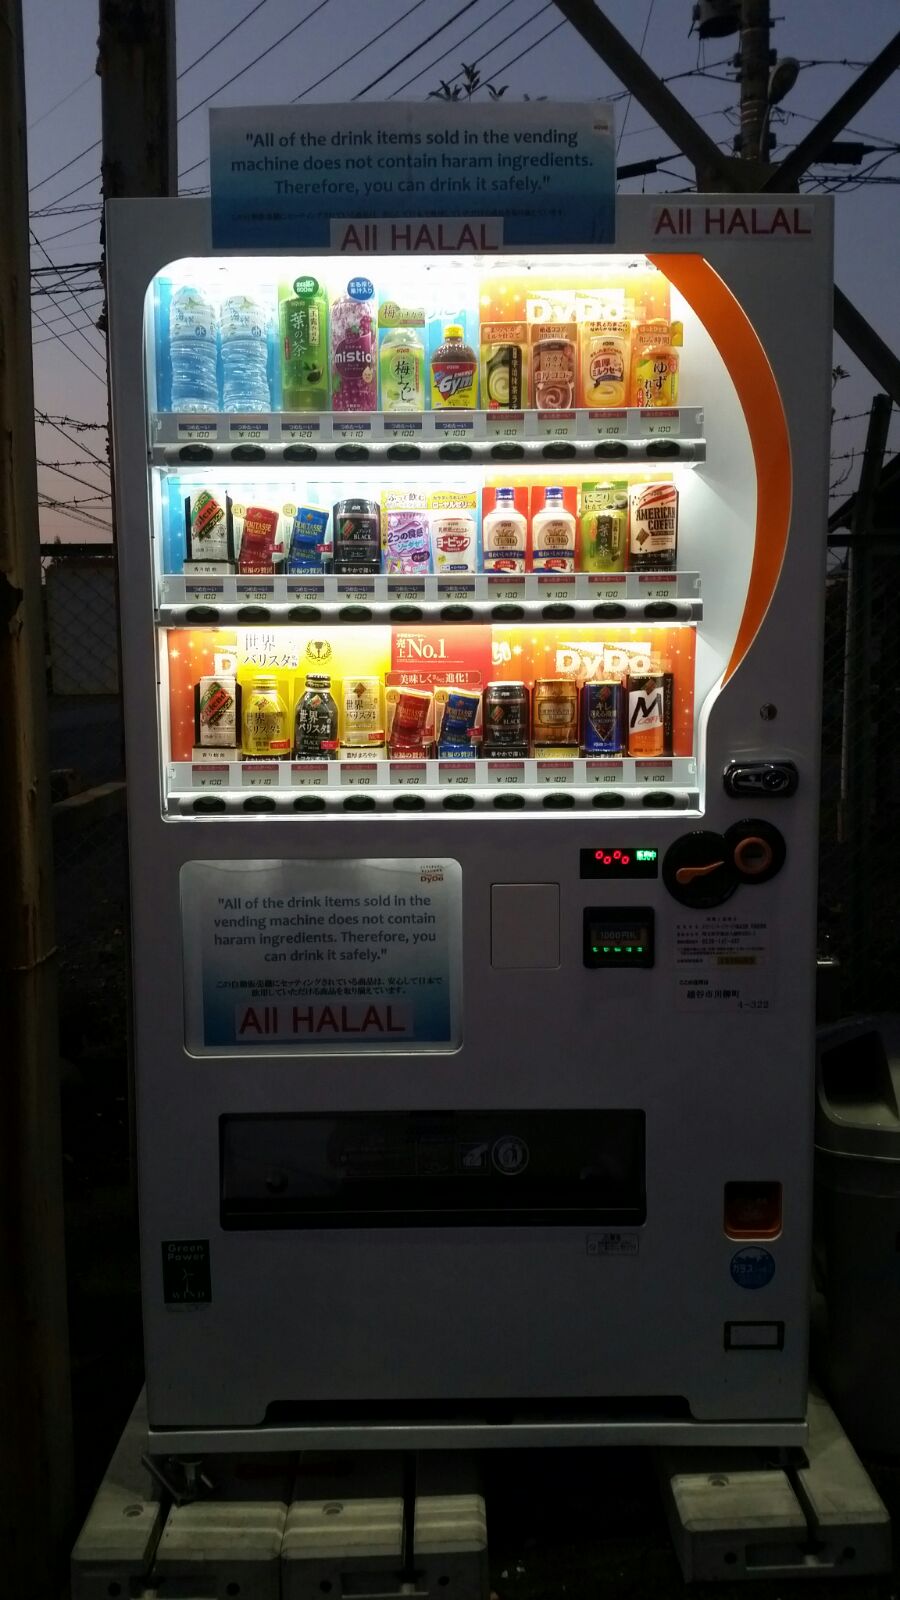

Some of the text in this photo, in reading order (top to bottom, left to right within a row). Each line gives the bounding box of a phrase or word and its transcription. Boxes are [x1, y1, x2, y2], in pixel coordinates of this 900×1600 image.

[279, 132, 296, 147] of
[300, 132, 326, 146] the
[331, 131, 373, 146] drink
[377, 130, 422, 145] items
[426, 130, 459, 145] sold
[464, 130, 478, 144] in
[483, 130, 509, 144] the
[514, 129, 578, 148] vending
[231, 152, 593, 172] machine does not contain haram ingredients.
[275, 180, 359, 195] Therefore,
[364, 181, 393, 196] you
[398, 181, 424, 192] can
[430, 177, 471, 192] drink
[476, 177, 487, 191] it
[655, 208, 812, 234] All HALAL
[341, 224, 499, 251] All HALAL
[290, 311, 307, 357] 葉の茶
[335, 351, 372, 363] mistio
[439, 375, 473, 396] Gym
[636, 507, 675, 521] AMERICAN
[436, 536, 471, 549] ヨービック
[406, 638, 448, 659] No.1
[243, 654, 291, 667] バリスタ
[556, 648, 651, 678] DyDo
[299, 723, 327, 734] バリスタ
[245, 896, 259, 909] of
[263, 896, 284, 909] the
[288, 895, 321, 908] drink
[324, 895, 360, 907] items
[363, 895, 391, 907] sold
[394, 895, 406, 906] in
[410, 894, 431, 906] the
[214, 912, 436, 930] vending machine does not contain
[214, 931, 436, 947] haram ingredients. Therefore, you
[264, 952, 287, 962] can
[290, 949, 324, 961] drink
[327, 949, 337, 960] it
[239, 1005, 406, 1034] All HALAL
[167, 1244, 204, 1253] Green
